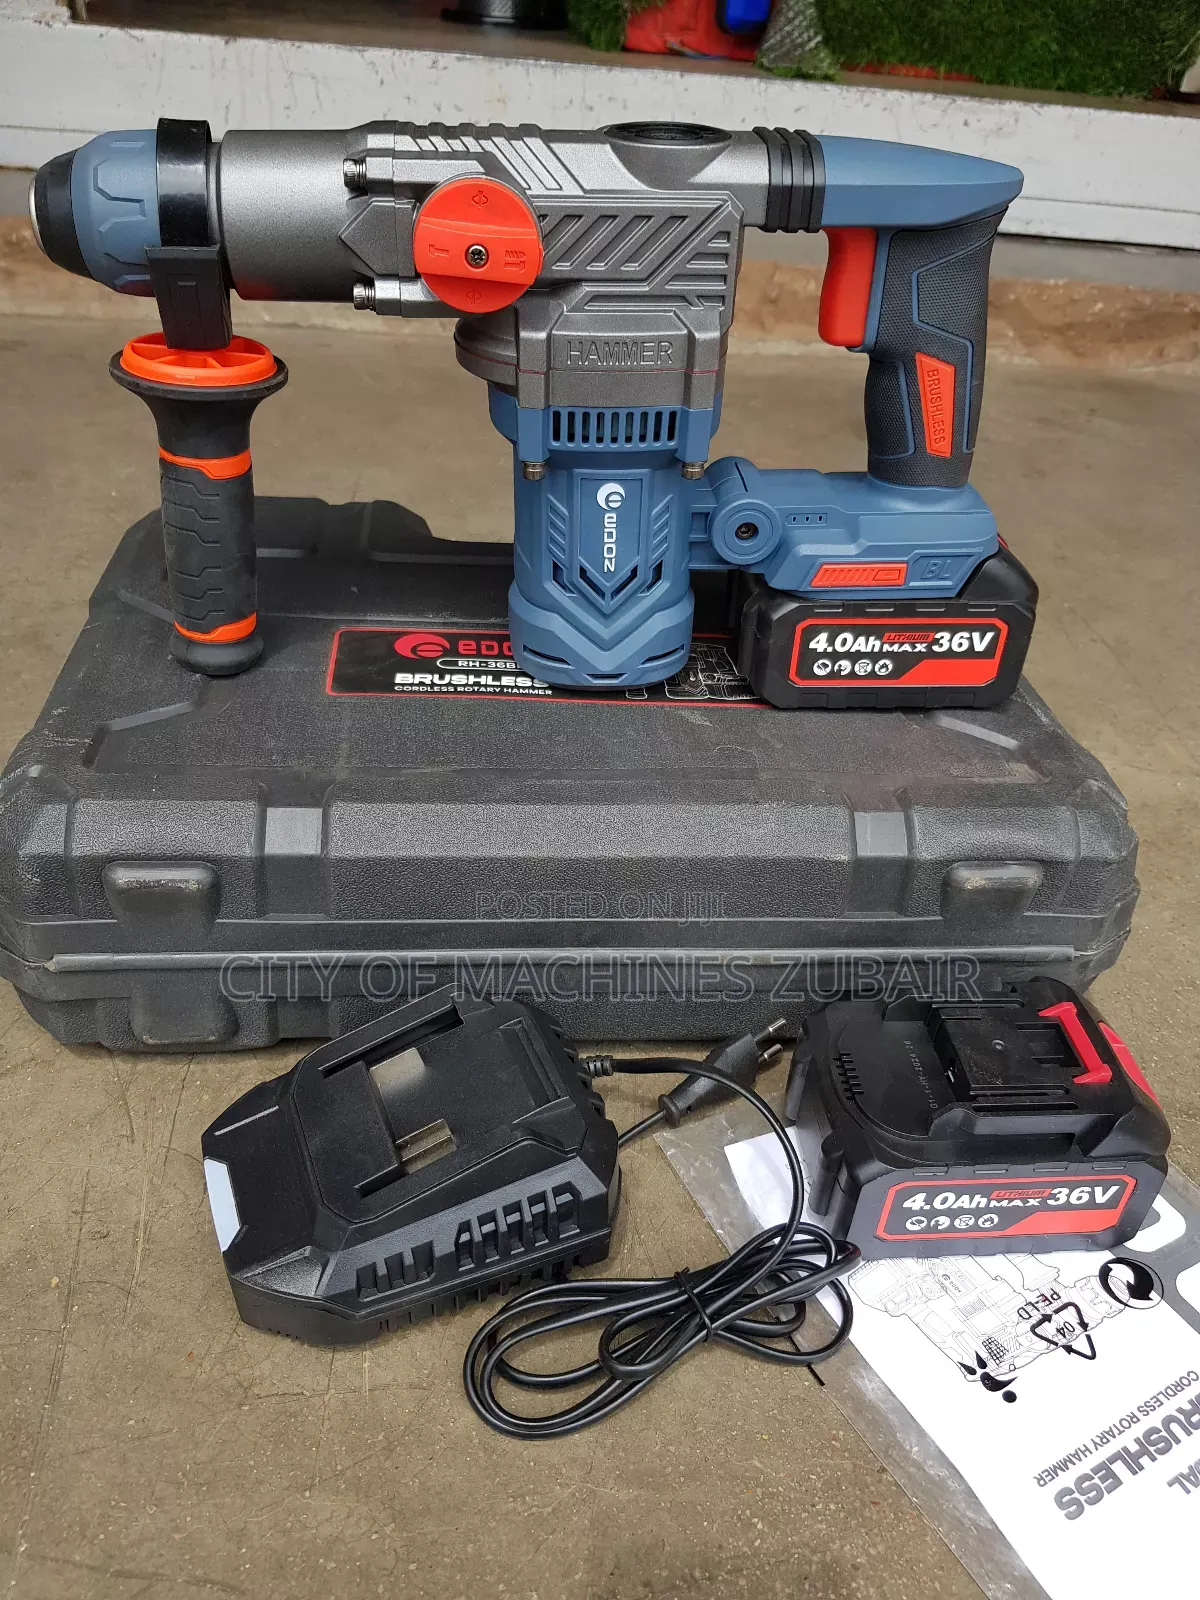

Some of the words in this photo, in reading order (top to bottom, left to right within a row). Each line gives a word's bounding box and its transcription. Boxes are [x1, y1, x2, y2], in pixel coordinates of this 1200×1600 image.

[566, 341, 674, 366] HAMMER
[926, 369, 946, 445] BRUSHLESS
[920, 560, 952, 580] BL
[808, 632, 881, 652] 4.0Ah
[882, 643, 928, 652] MAX
[932, 632, 995, 652] 36V
[885, 633, 931, 642] LITHIUM
[394, 673, 550, 688] BRUSHLESS
[457, 686, 501, 694] ROTARY
[503, 687, 553, 696] HAMMER
[902, 1192, 988, 1210] 4.0Ah
[988, 1198, 1043, 1208] MAX
[1046, 1185, 1120, 1206] 36V
[994, 1189, 1047, 1198] LITHIUM
[1017, 1288, 1062, 1321] PE-LD
[1055, 1321, 1076, 1339] 04
[1137, 1370, 1200, 1417] CORDLESS
[1090, 1411, 1142, 1452] ROTARY
[1032, 1443, 1094, 1488] HAMMER
[1166, 1458, 1200, 1495] AL
